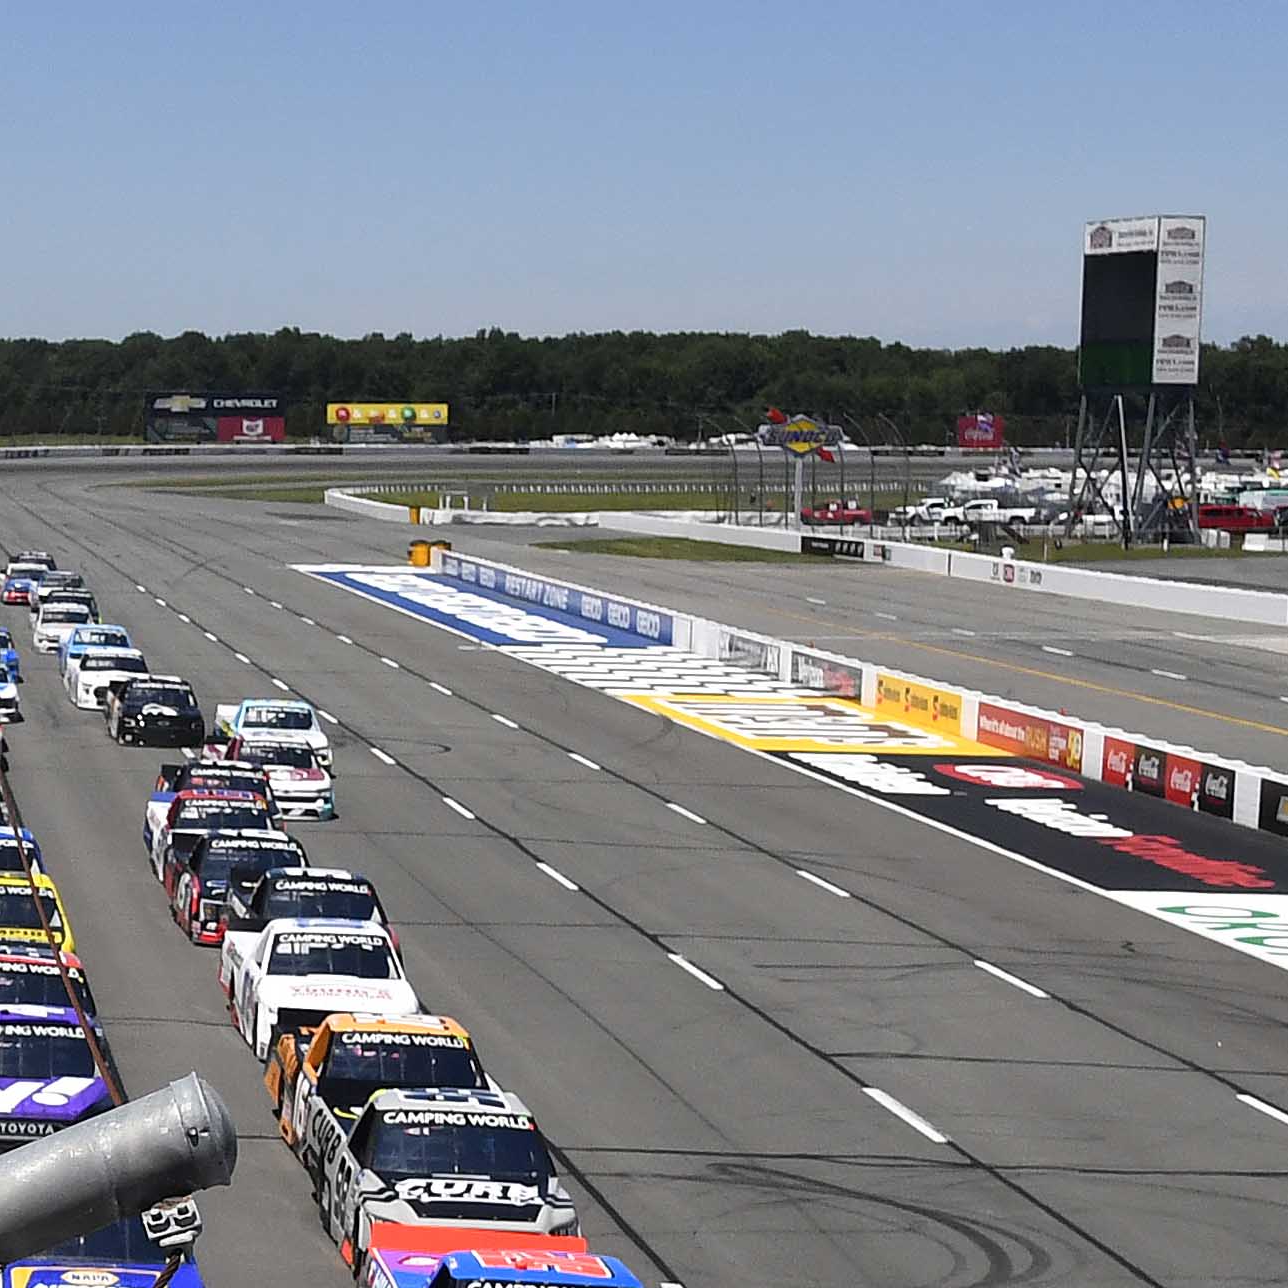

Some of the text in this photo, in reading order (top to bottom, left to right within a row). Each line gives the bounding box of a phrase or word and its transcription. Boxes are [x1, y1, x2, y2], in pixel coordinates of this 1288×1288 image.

[505, 574, 569, 610] RESTART ZONE
[279, 934, 383, 946] CAMPING WORLD
[342, 1032, 465, 1049] CAMPING WORLD
[0, 1122, 55, 1135] TOYOTA
[383, 1111, 530, 1131] CAMPING WORLD
[312, 1108, 341, 1165] CURB
